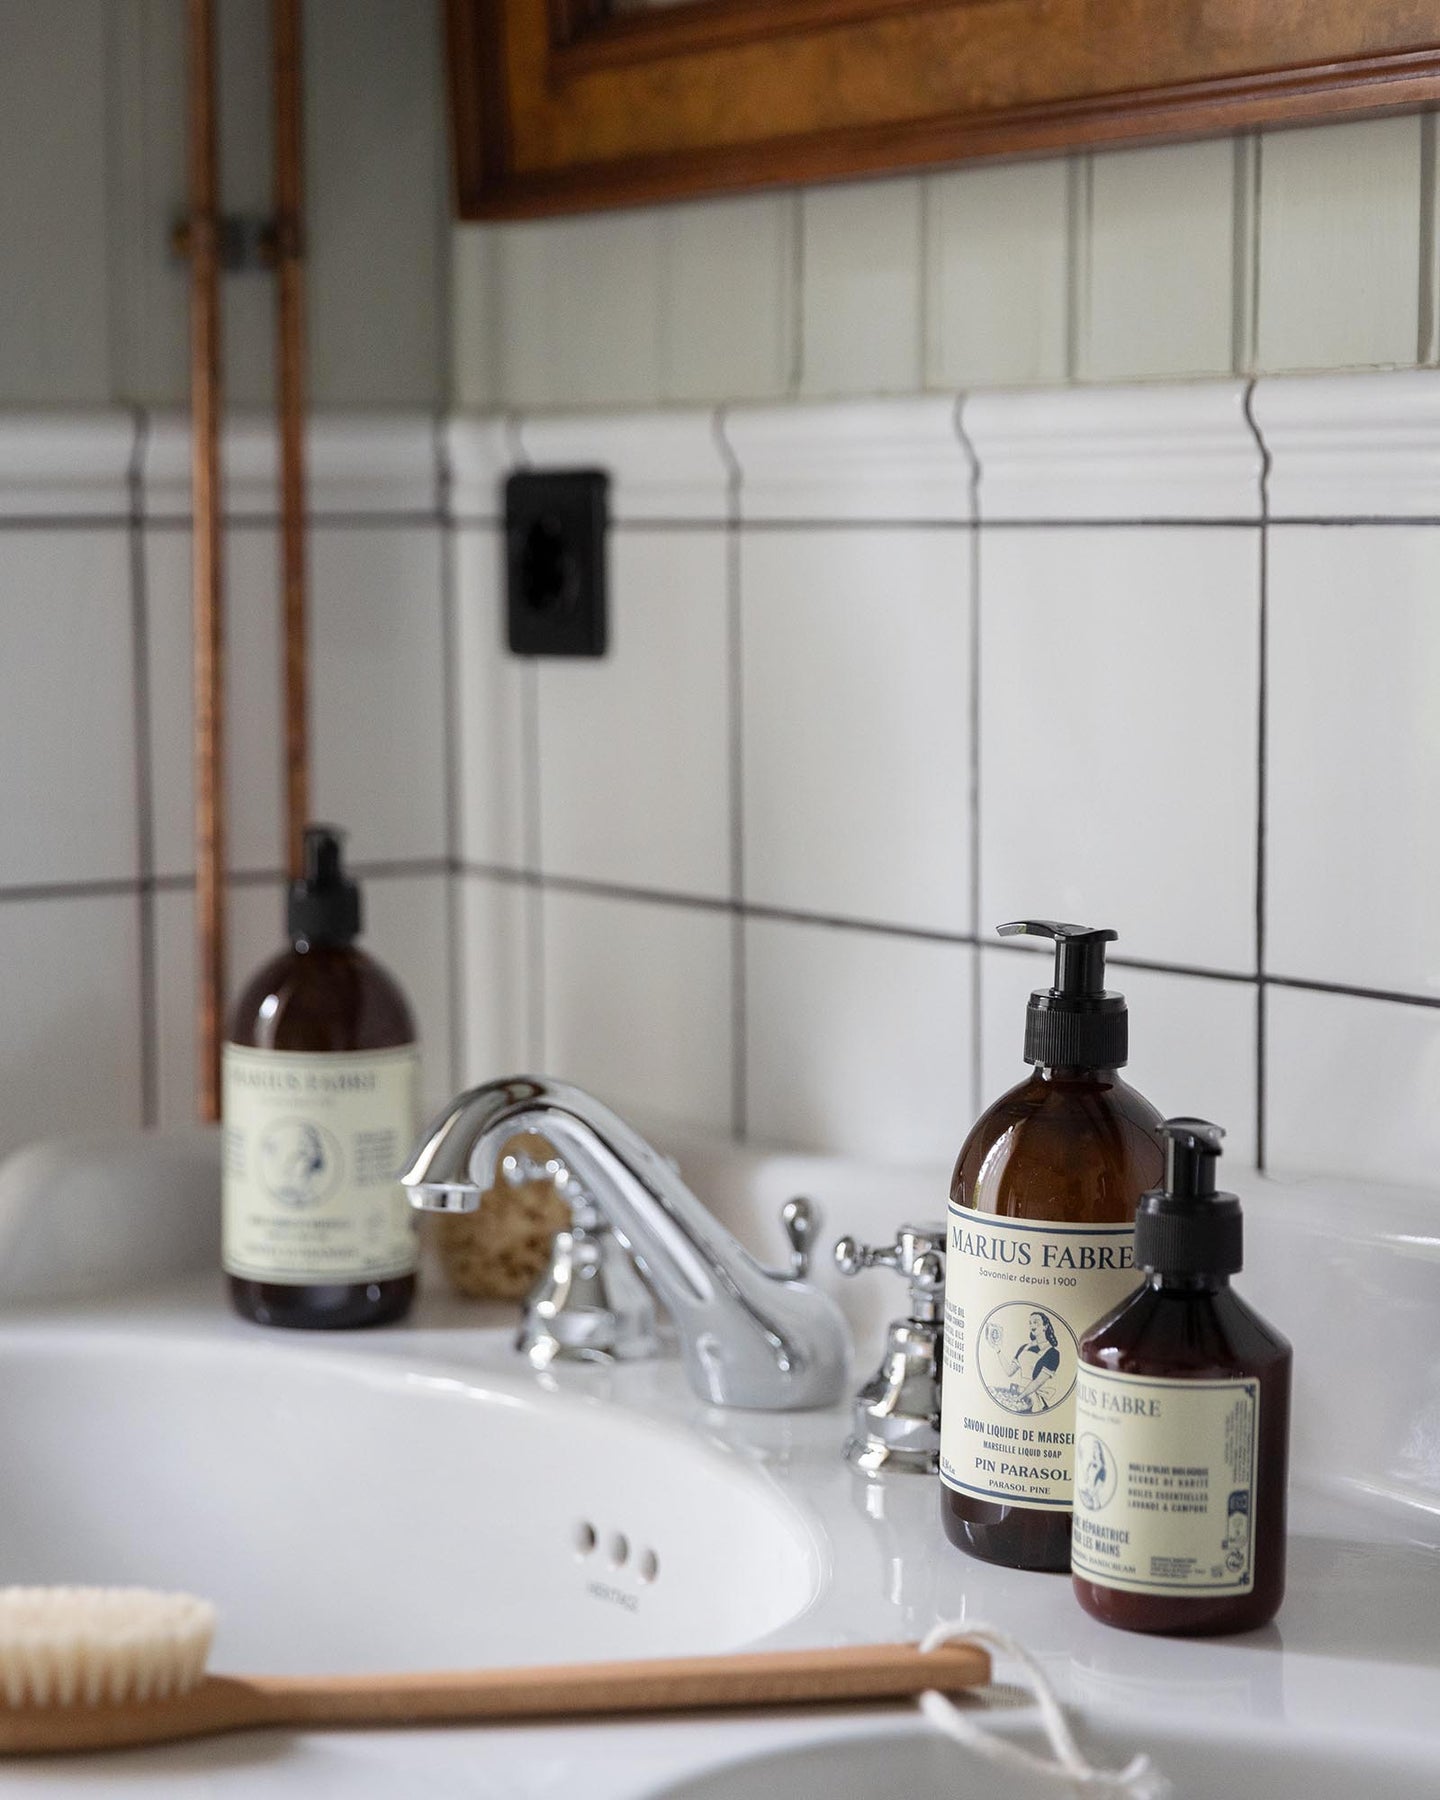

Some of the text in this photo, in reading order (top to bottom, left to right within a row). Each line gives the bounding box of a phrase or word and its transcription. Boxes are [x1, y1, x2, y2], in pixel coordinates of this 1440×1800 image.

[952, 1226, 1135, 1270] MARIUS FABRE
[979, 1267, 1077, 1287] Savonnier depuis 1900
[1102, 1391, 1161, 1418] FABRE
[963, 1417, 985, 1434] SAVON
[987, 1424, 1019, 1440] LIQUIDE
[1022, 1430, 1034, 1441] DE
[983, 1440, 1062, 1459] MARSEILLE LIQUID SOAP
[975, 1457, 996, 1473] PIN
[1001, 1463, 1072, 1481] PARASOL
[989, 1479, 1051, 1495] PARASOL PINE
[1095, 1539, 1121, 1558] MAINS
